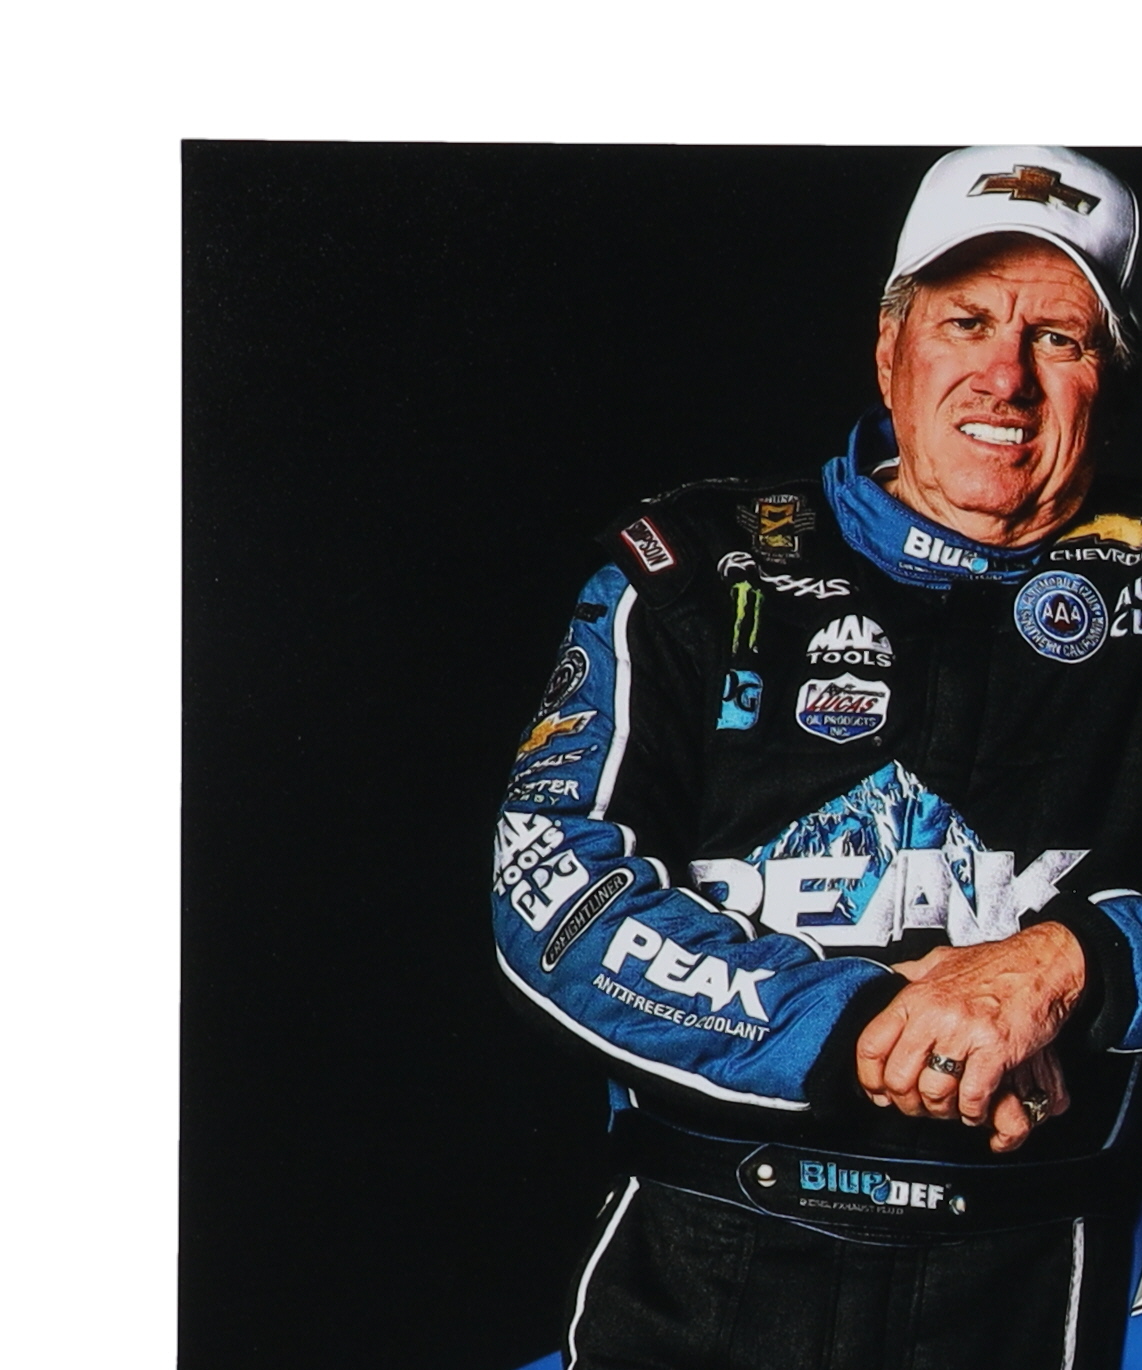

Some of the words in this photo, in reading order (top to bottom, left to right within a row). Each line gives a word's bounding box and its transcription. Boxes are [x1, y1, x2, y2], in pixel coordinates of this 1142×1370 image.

[626, 522, 668, 567] SIMPSON
[807, 614, 893, 656] MAC
[1041, 602, 1082, 624] AAA
[806, 650, 893, 668] TOOLS
[806, 694, 879, 712] LUCAS
[824, 714, 877, 727] PRODUCTS
[494, 826, 564, 896] TOOLS
[516, 850, 578, 921] PPG
[548, 875, 623, 959] FREIGHTLINER
[689, 848, 1092, 948] PEAK
[601, 917, 776, 1023] PEAK
[593, 973, 683, 1026] ANTIFREEZE
[800, 1160, 884, 1197] Blue
[886, 1181, 945, 1210] DEF
